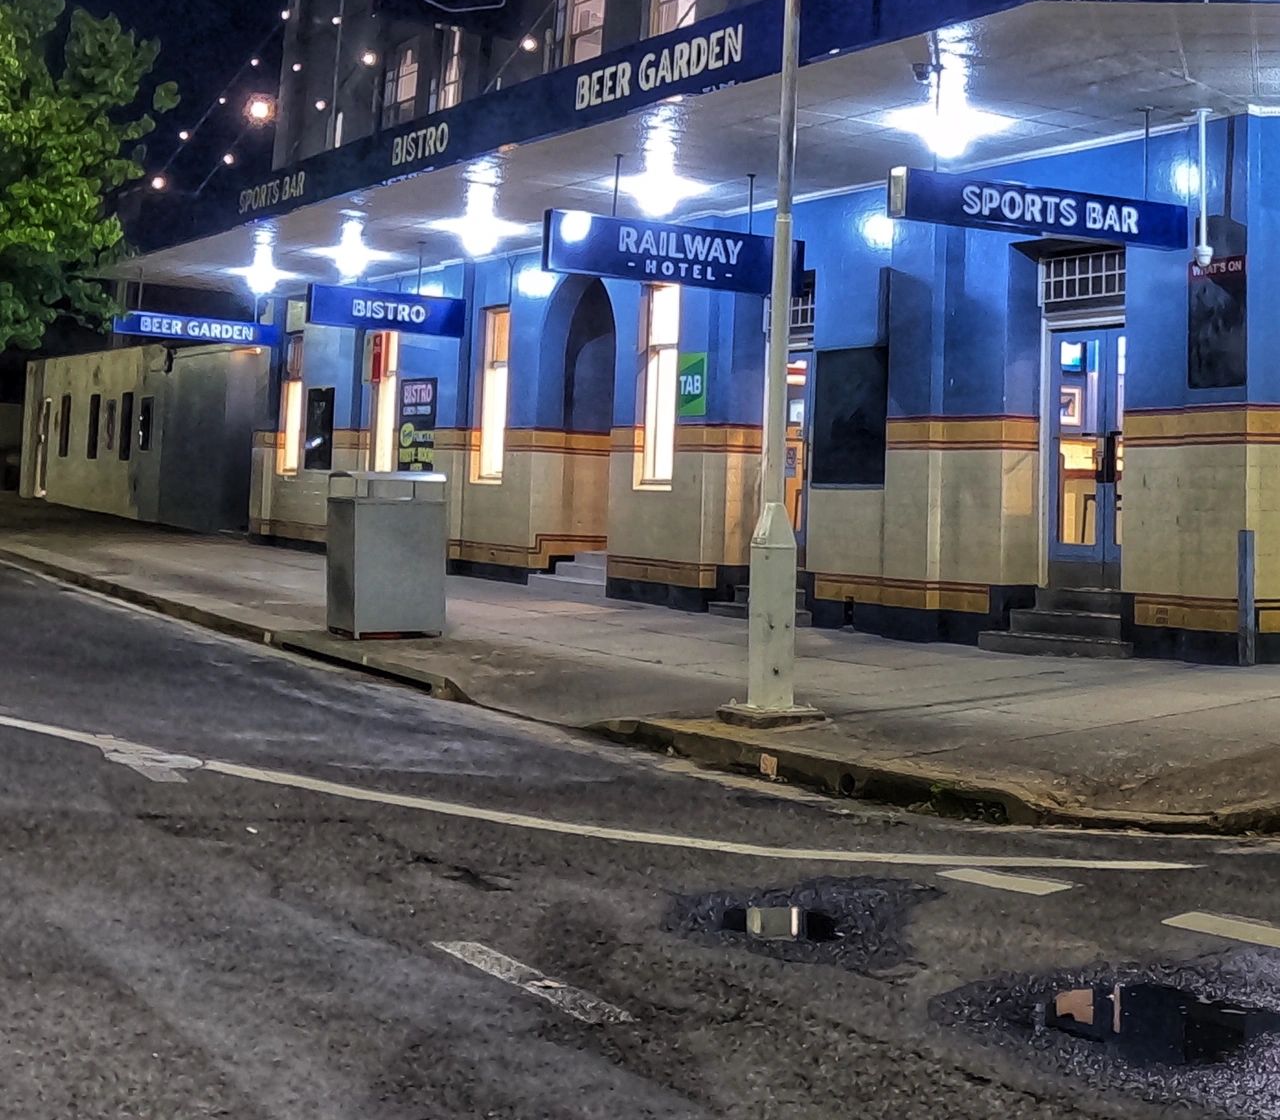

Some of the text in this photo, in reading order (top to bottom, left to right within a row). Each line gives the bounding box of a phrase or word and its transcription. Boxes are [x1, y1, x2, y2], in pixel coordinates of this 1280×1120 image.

[575, 23, 743, 111] BEER GARDEN
[391, 122, 449, 166] BISTRO
[239, 171, 306, 214] SPORTS BAR
[962, 185, 1139, 234] SPORTS BAR
[618, 226, 743, 265] RAILWAY
[645, 260, 716, 280] HOTEL
[1228, 260, 1242, 272] ON
[352, 299, 426, 323] BISTRO
[140, 316, 254, 340] BEER GARDEN
[403, 383, 433, 404] BISTRO
[679, 375, 702, 395] TAB
